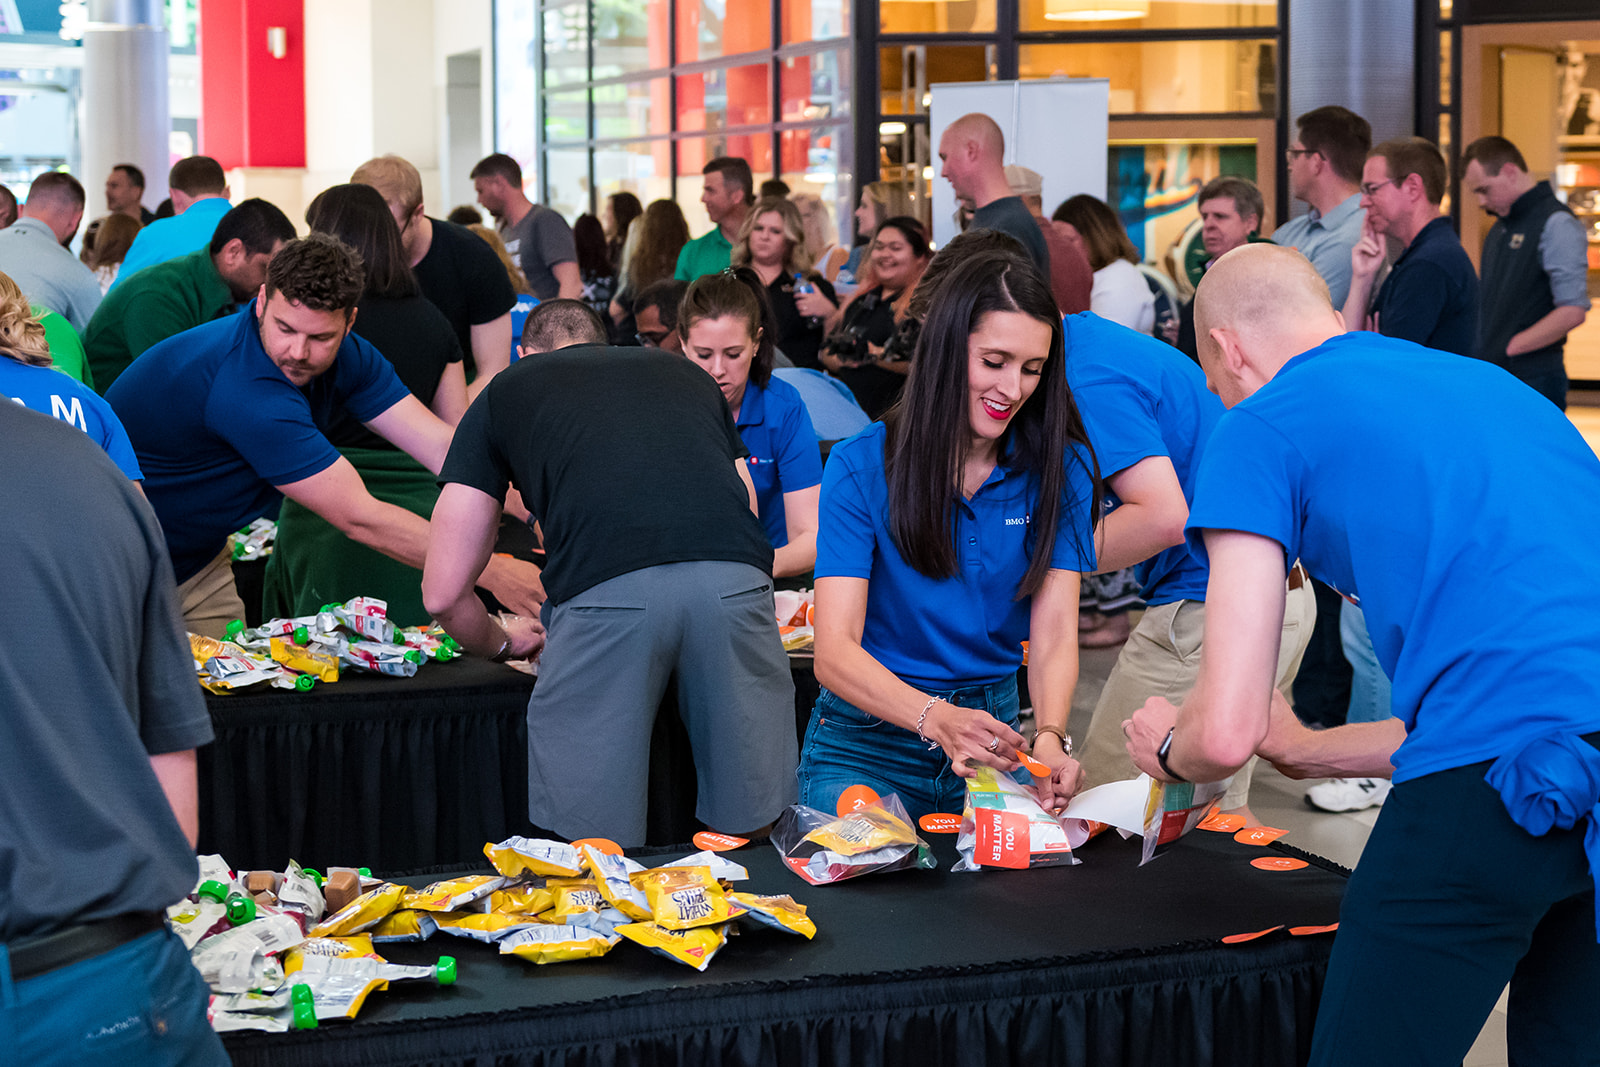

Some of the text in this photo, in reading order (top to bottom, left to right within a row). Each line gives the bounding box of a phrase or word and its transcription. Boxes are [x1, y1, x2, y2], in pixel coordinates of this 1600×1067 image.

[1005, 517, 1025, 526] BMO
[700, 833, 739, 847] MATTER
[992, 813, 1002, 862] MATTER
[1005, 826, 1015, 851] YOU
[677, 903, 715, 921] WHEAT
